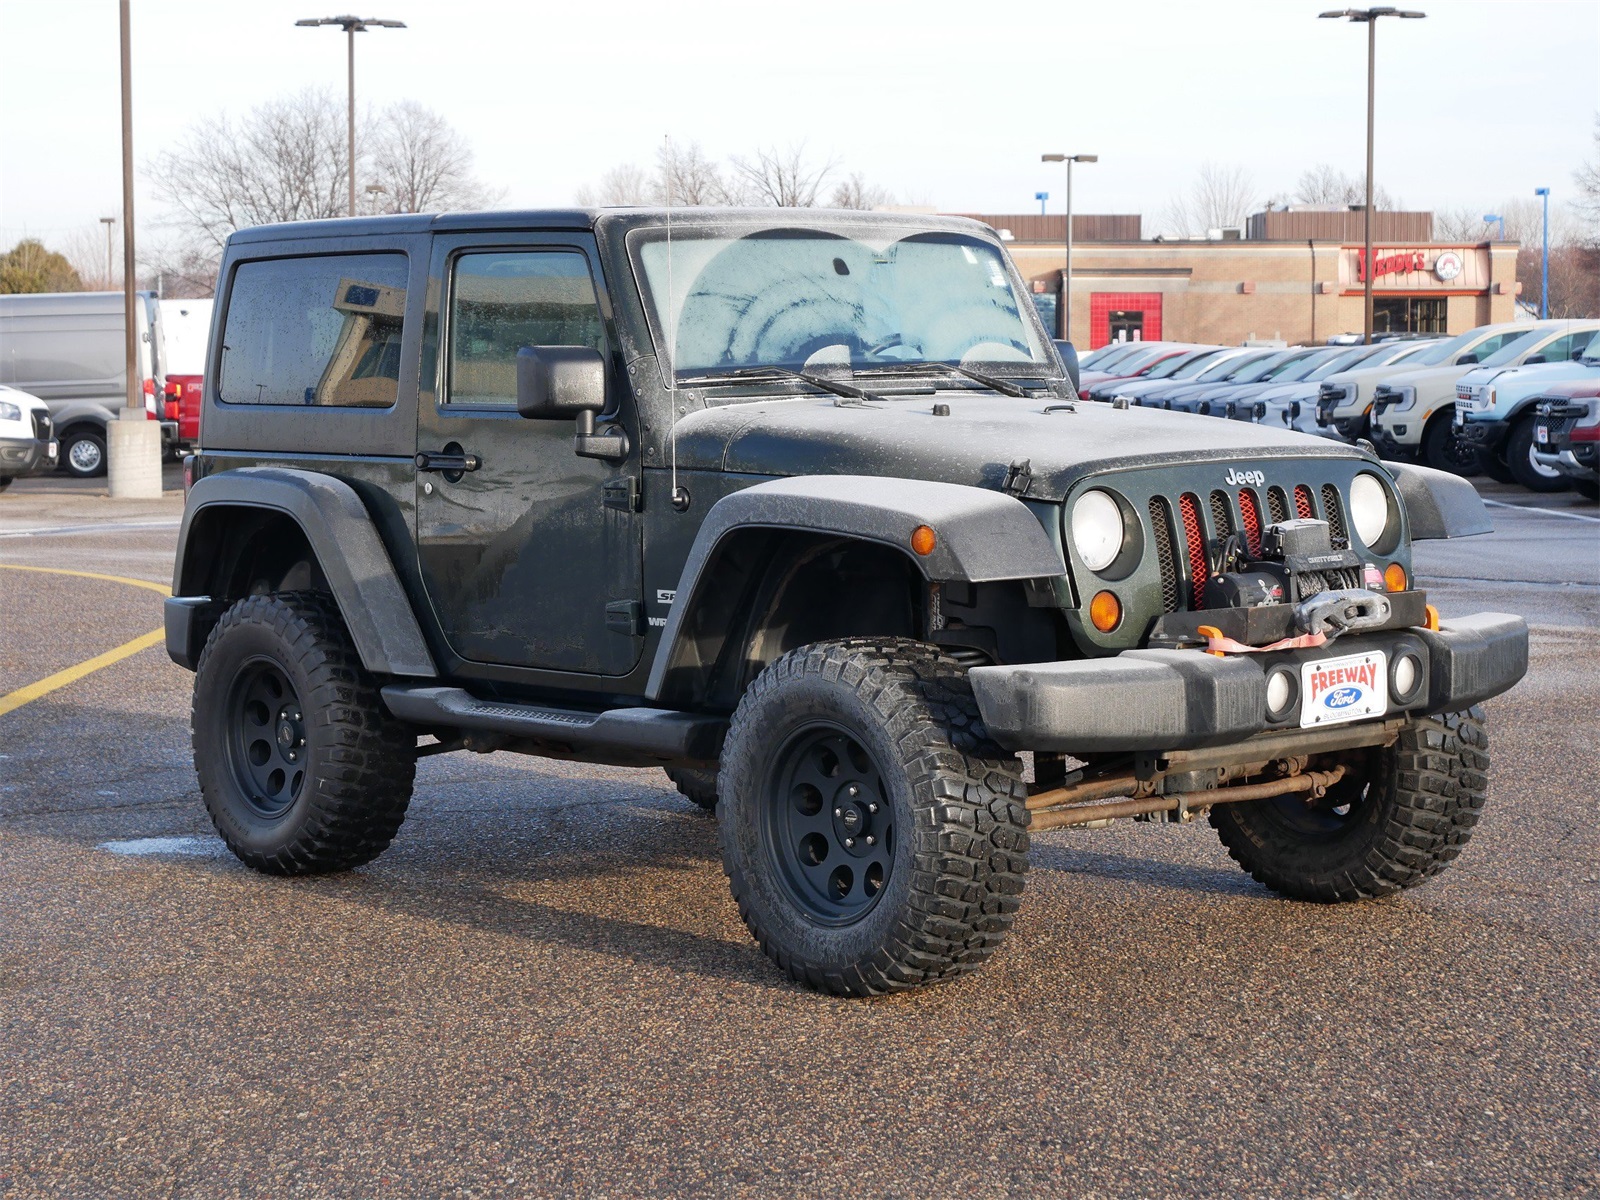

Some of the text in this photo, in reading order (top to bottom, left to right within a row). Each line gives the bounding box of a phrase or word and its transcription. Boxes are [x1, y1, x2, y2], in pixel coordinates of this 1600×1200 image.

[1225, 467, 1265, 488] Jeep
[1310, 662, 1377, 704] FREEWAY
[1330, 689, 1356, 707] Ford
[1323, 707, 1363, 720] BLOOMINGTON
